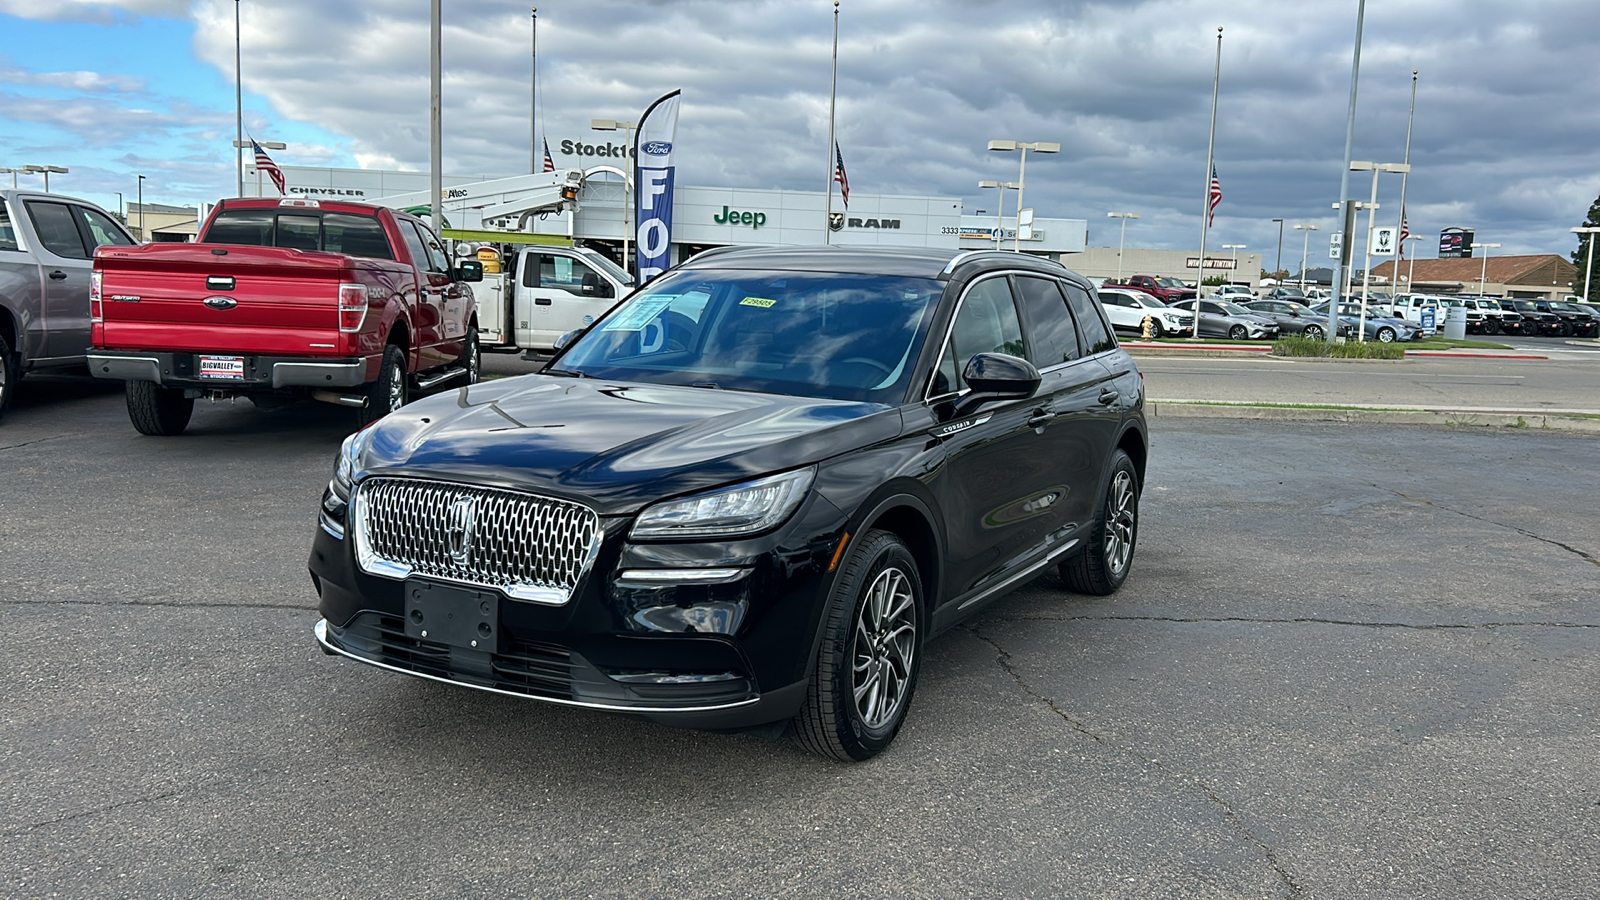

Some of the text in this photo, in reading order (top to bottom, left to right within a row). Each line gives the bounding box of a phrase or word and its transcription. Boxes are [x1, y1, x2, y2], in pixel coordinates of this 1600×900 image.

[646, 142, 670, 154] Ford
[290, 187, 364, 197] CHRYSLER
[448, 188, 468, 198] Altec
[714, 206, 766, 230] Jeep
[848, 218, 900, 229] RAM
[941, 227, 959, 235] 3333
[1187, 259, 1213, 268] WINOW
[202, 362, 234, 370] BIGVALLEY
[943, 420, 971, 433] CORSAIR
